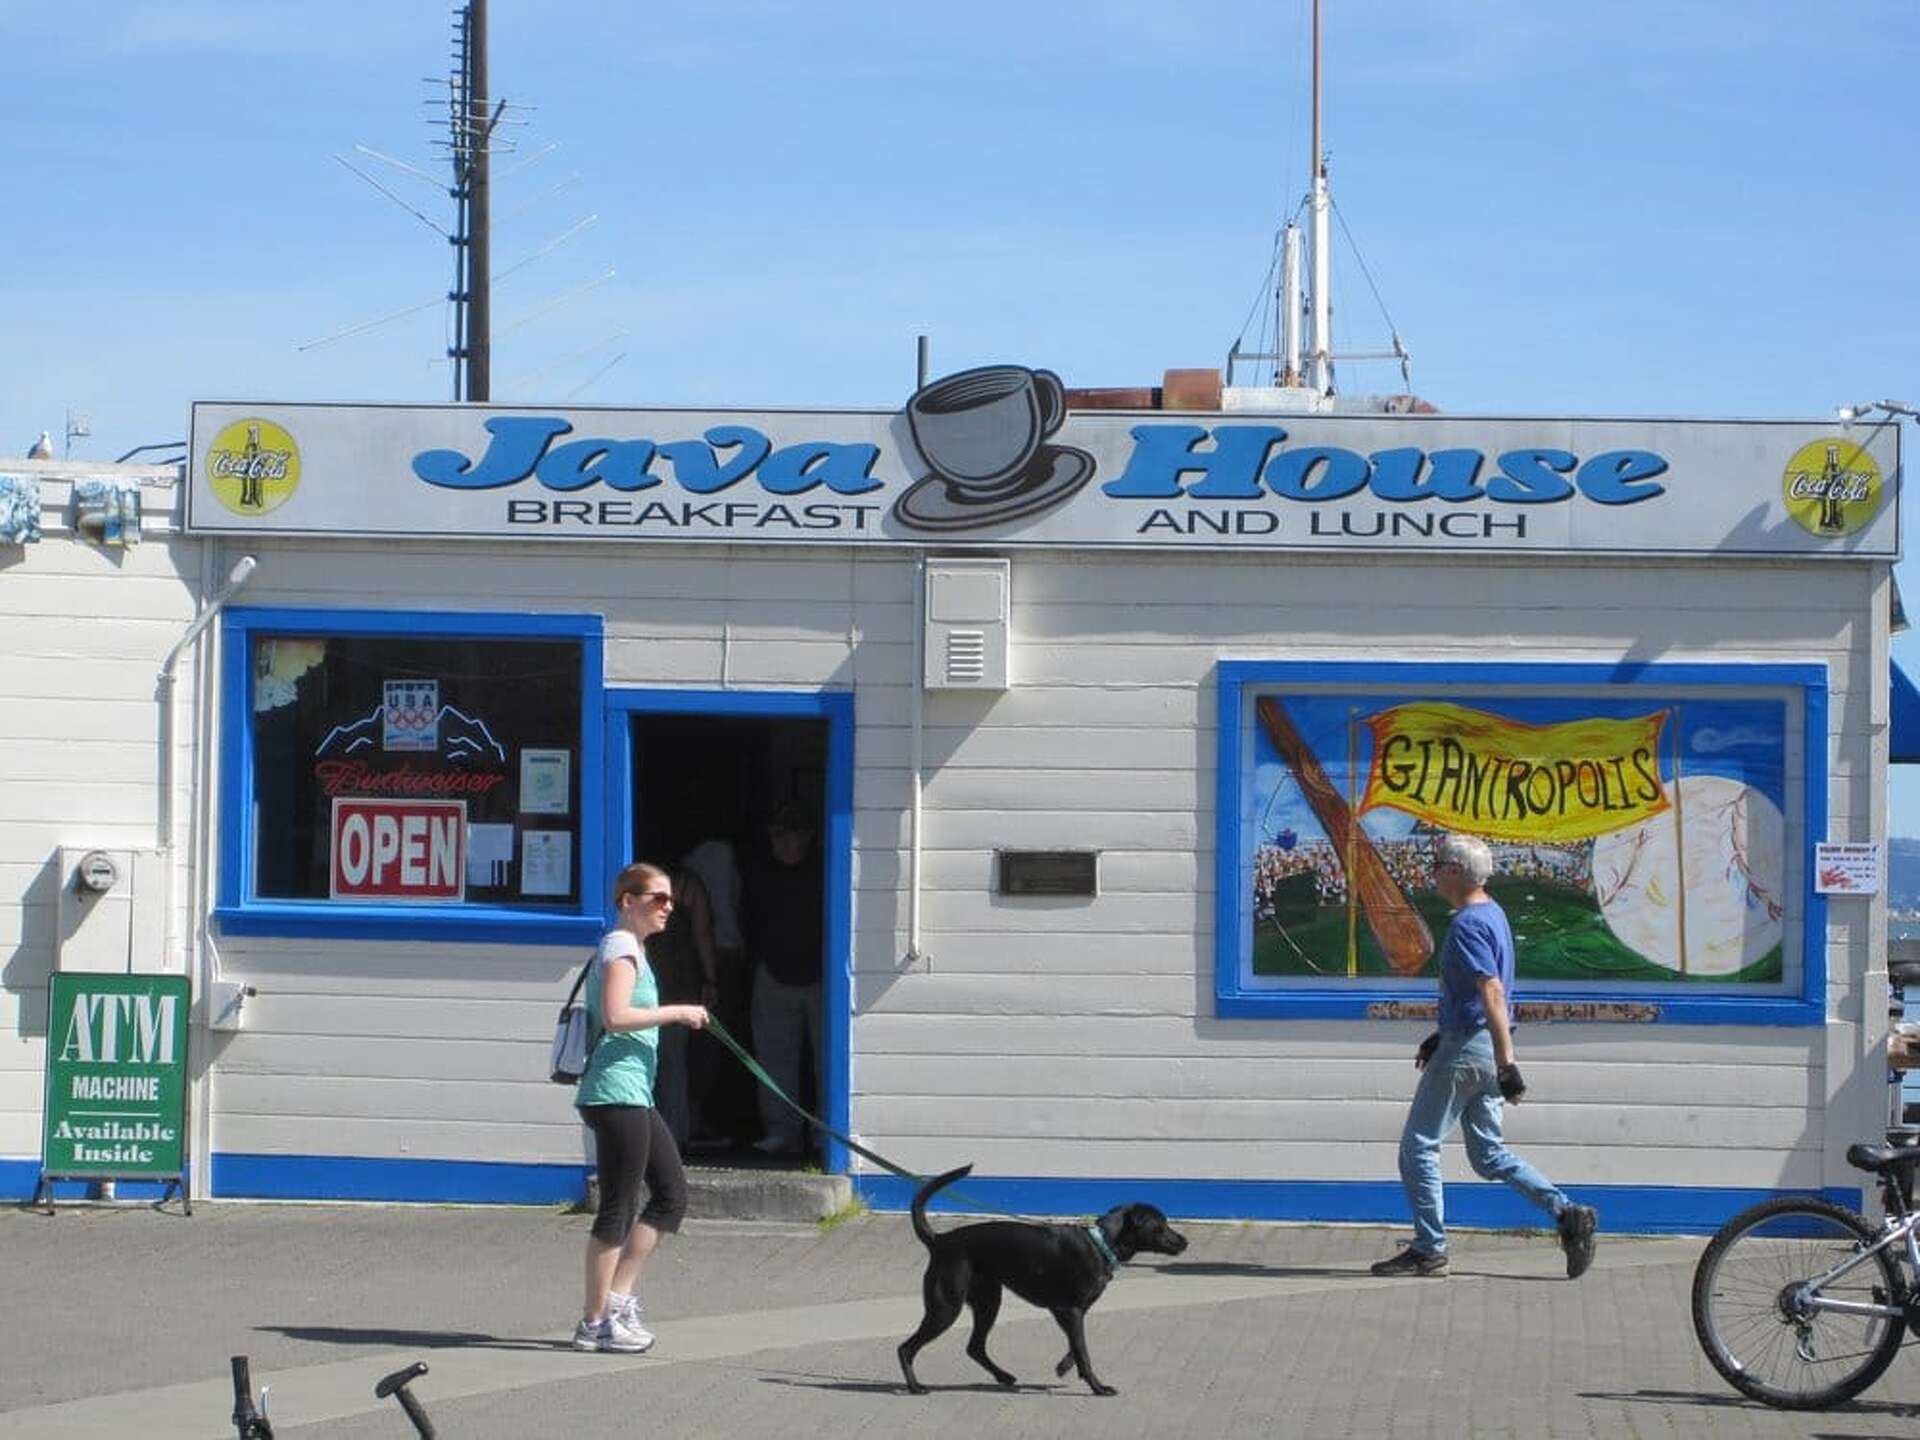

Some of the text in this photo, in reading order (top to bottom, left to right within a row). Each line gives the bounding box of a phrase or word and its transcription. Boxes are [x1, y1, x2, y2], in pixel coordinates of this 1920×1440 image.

[412, 415, 1669, 506] Java House
[507, 499, 1527, 539] BREAKFAST AND LUNCH
[315, 760, 505, 796] Budweiser
[1381, 733, 1660, 820] GIANTROPOLIS
[340, 813, 458, 886] OPEN
[58, 992, 179, 1064] ATM
[71, 1075, 160, 1101] MACHINE
[54, 1119, 175, 1142] Available
[72, 1143, 155, 1164] Inside
